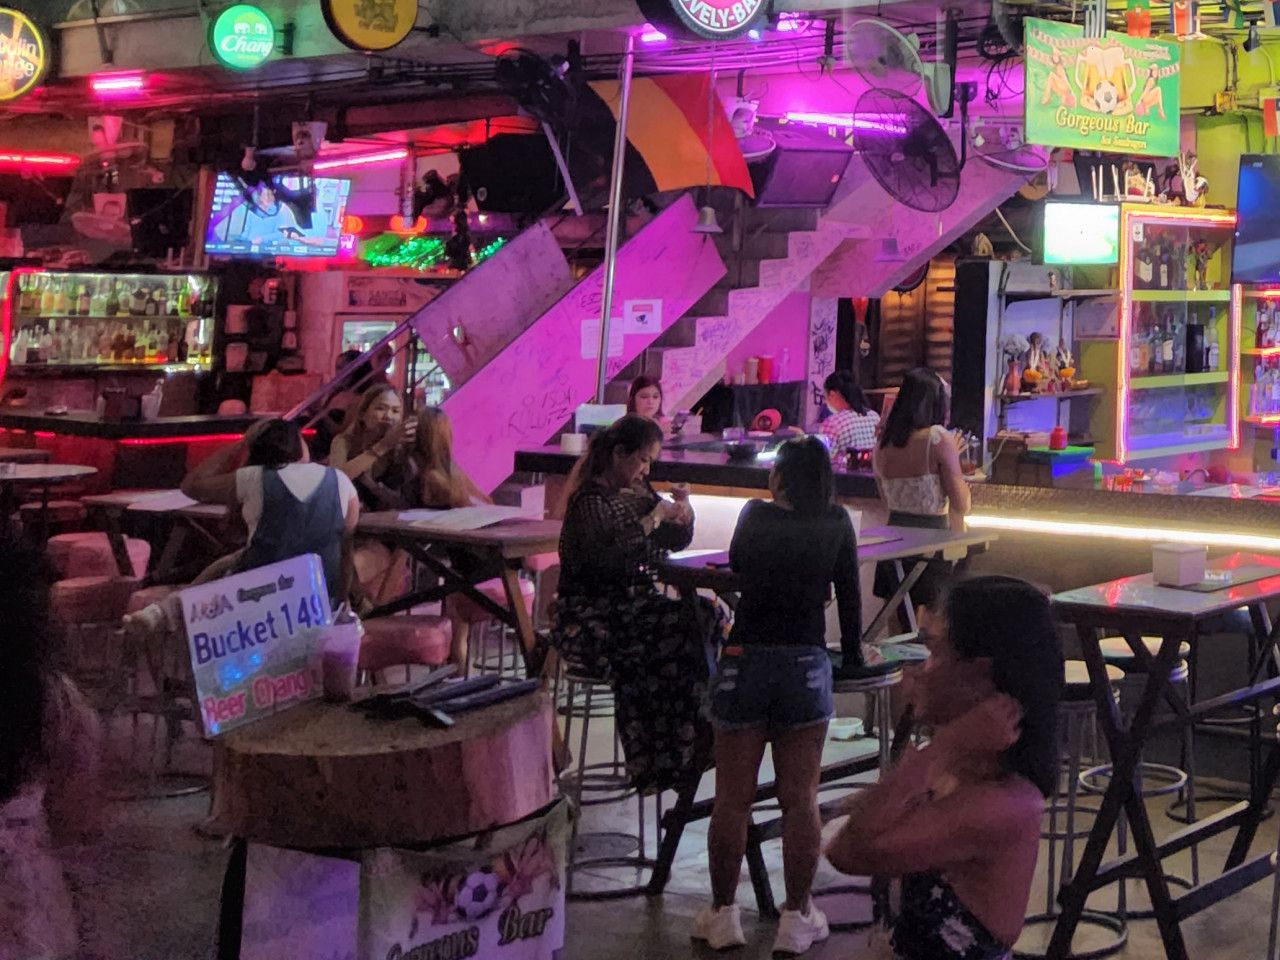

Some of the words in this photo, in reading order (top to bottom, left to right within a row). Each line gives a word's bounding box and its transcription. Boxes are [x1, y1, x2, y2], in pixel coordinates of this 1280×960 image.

[221, 34, 273, 57] Chang
[1055, 106, 1120, 136] Gorgeous
[1125, 113, 1150, 136] Bar
[193, 610, 278, 665] Bucket
[280, 593, 325, 636] 149
[204, 692, 246, 722] Beer
[497, 900, 554, 946] Bar
